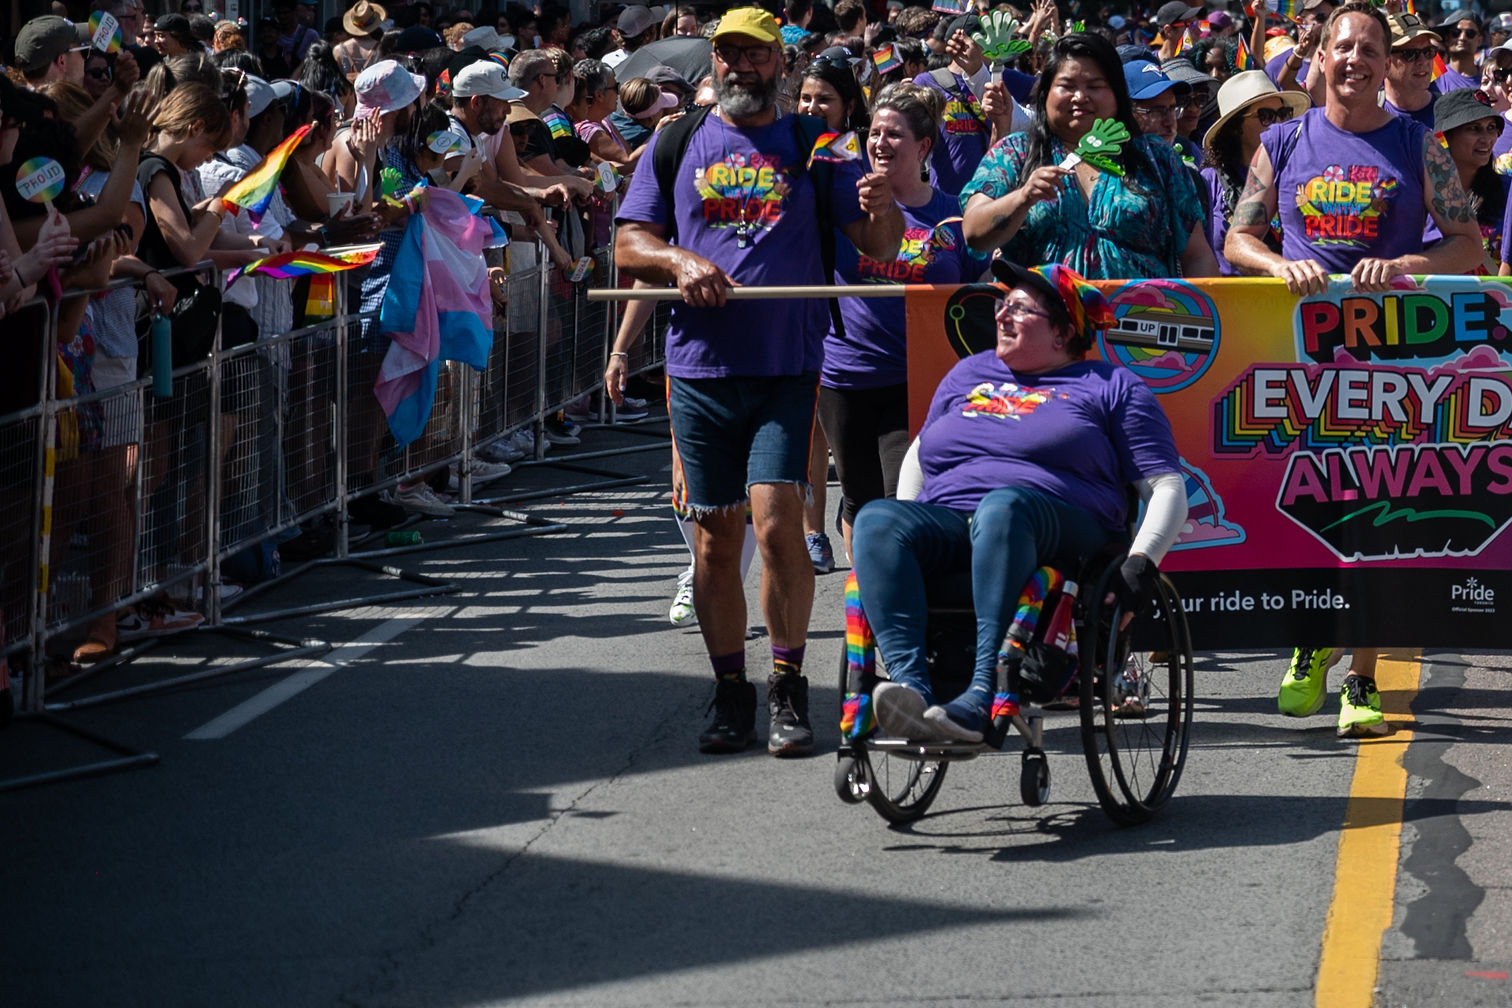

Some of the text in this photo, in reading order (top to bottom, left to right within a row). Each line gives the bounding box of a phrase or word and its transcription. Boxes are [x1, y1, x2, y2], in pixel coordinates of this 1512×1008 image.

[22, 165, 60, 195] PROUD
[711, 166, 775, 188] RIDE
[1310, 181, 1373, 203] RIDE
[703, 199, 781, 222] PRIDE
[1321, 201, 1361, 217] WITH
[1304, 215, 1379, 239] PRIDE
[857, 255, 928, 283] PRIDE
[1140, 322, 1156, 333] UP
[1253, 369, 1455, 425] EVERY
[1210, 592, 1254, 612] ride
[1261, 593, 1285, 611] to
[1291, 590, 1351, 611] Pride.
[1451, 579, 1495, 601] Pride
